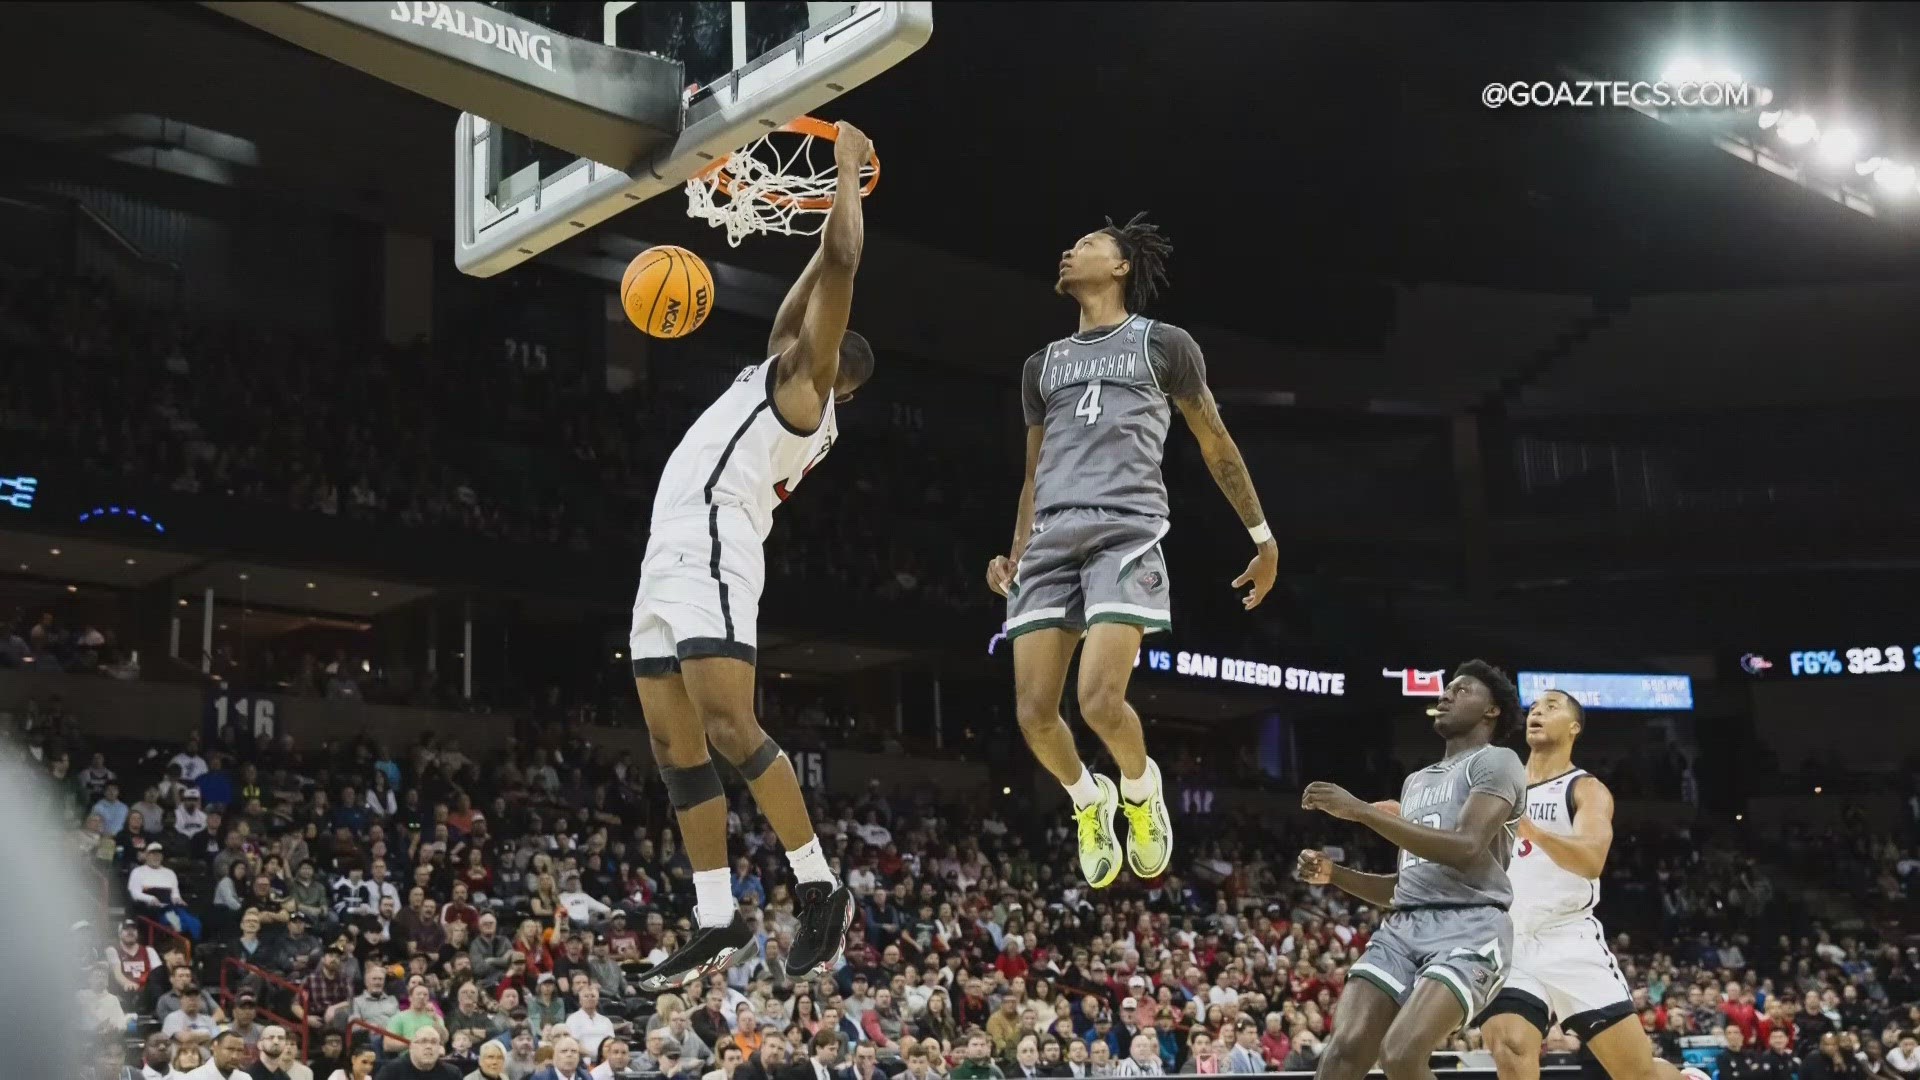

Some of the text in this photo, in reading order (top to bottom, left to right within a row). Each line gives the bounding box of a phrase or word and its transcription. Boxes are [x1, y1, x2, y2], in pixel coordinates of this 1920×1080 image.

[391, 1, 556, 73] SPALDING
[1050, 353, 1137, 390] BIRMINGHAM
[1075, 380, 1103, 427] 4
[1149, 649, 1171, 670] VS
[1177, 651, 1217, 678] SAN
[1221, 657, 1282, 688] DIEGO
[1285, 667, 1345, 696] STATE
[1790, 650, 1842, 676] FG%
[1846, 645, 1905, 675] 32.3
[786, 752, 823, 788] 15
